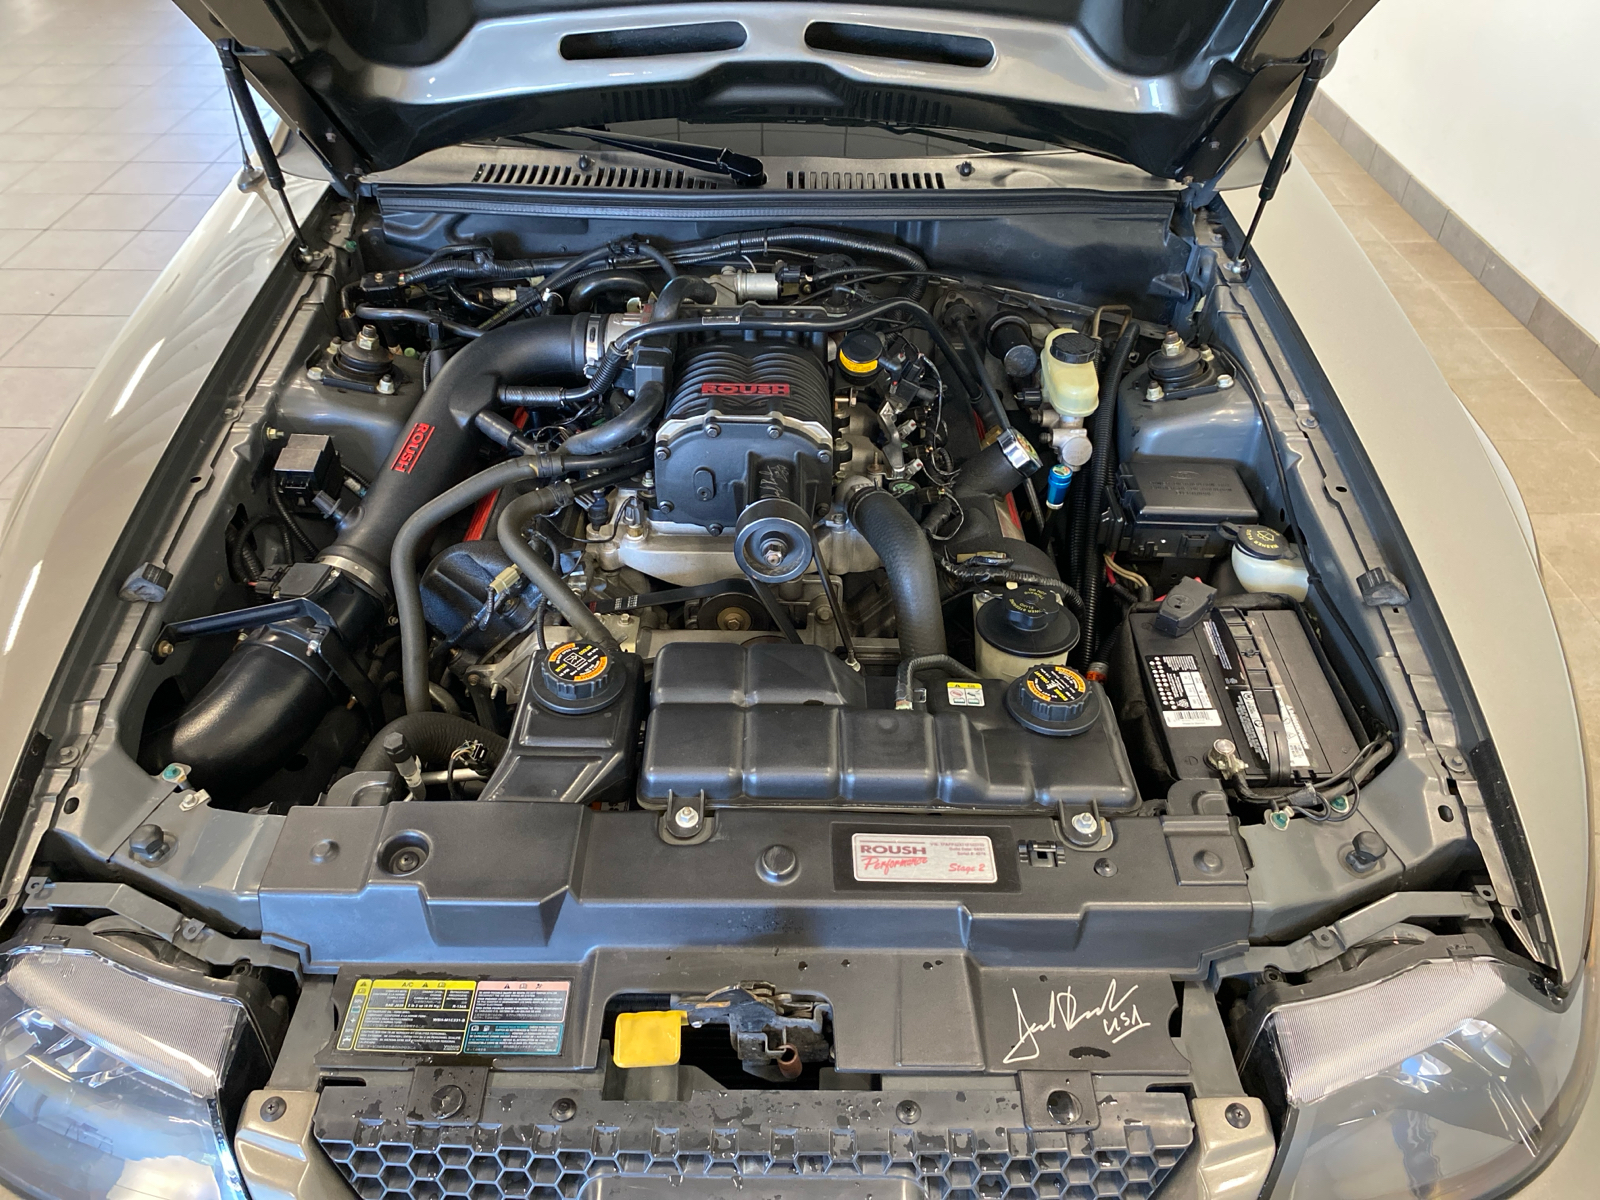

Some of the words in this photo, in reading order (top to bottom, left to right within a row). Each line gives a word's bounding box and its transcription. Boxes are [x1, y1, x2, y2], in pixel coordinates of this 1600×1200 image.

[702, 383, 790, 395] ROUSH
[394, 422, 430, 473] ROUSH
[1254, 540, 1279, 549] WASHER
[860, 845, 927, 855] ROUSH
[861, 855, 928, 875] Performance
[948, 863, 975, 874] Stage
[978, 863, 985, 872] 2
[1103, 1004, 1150, 1035] USA
